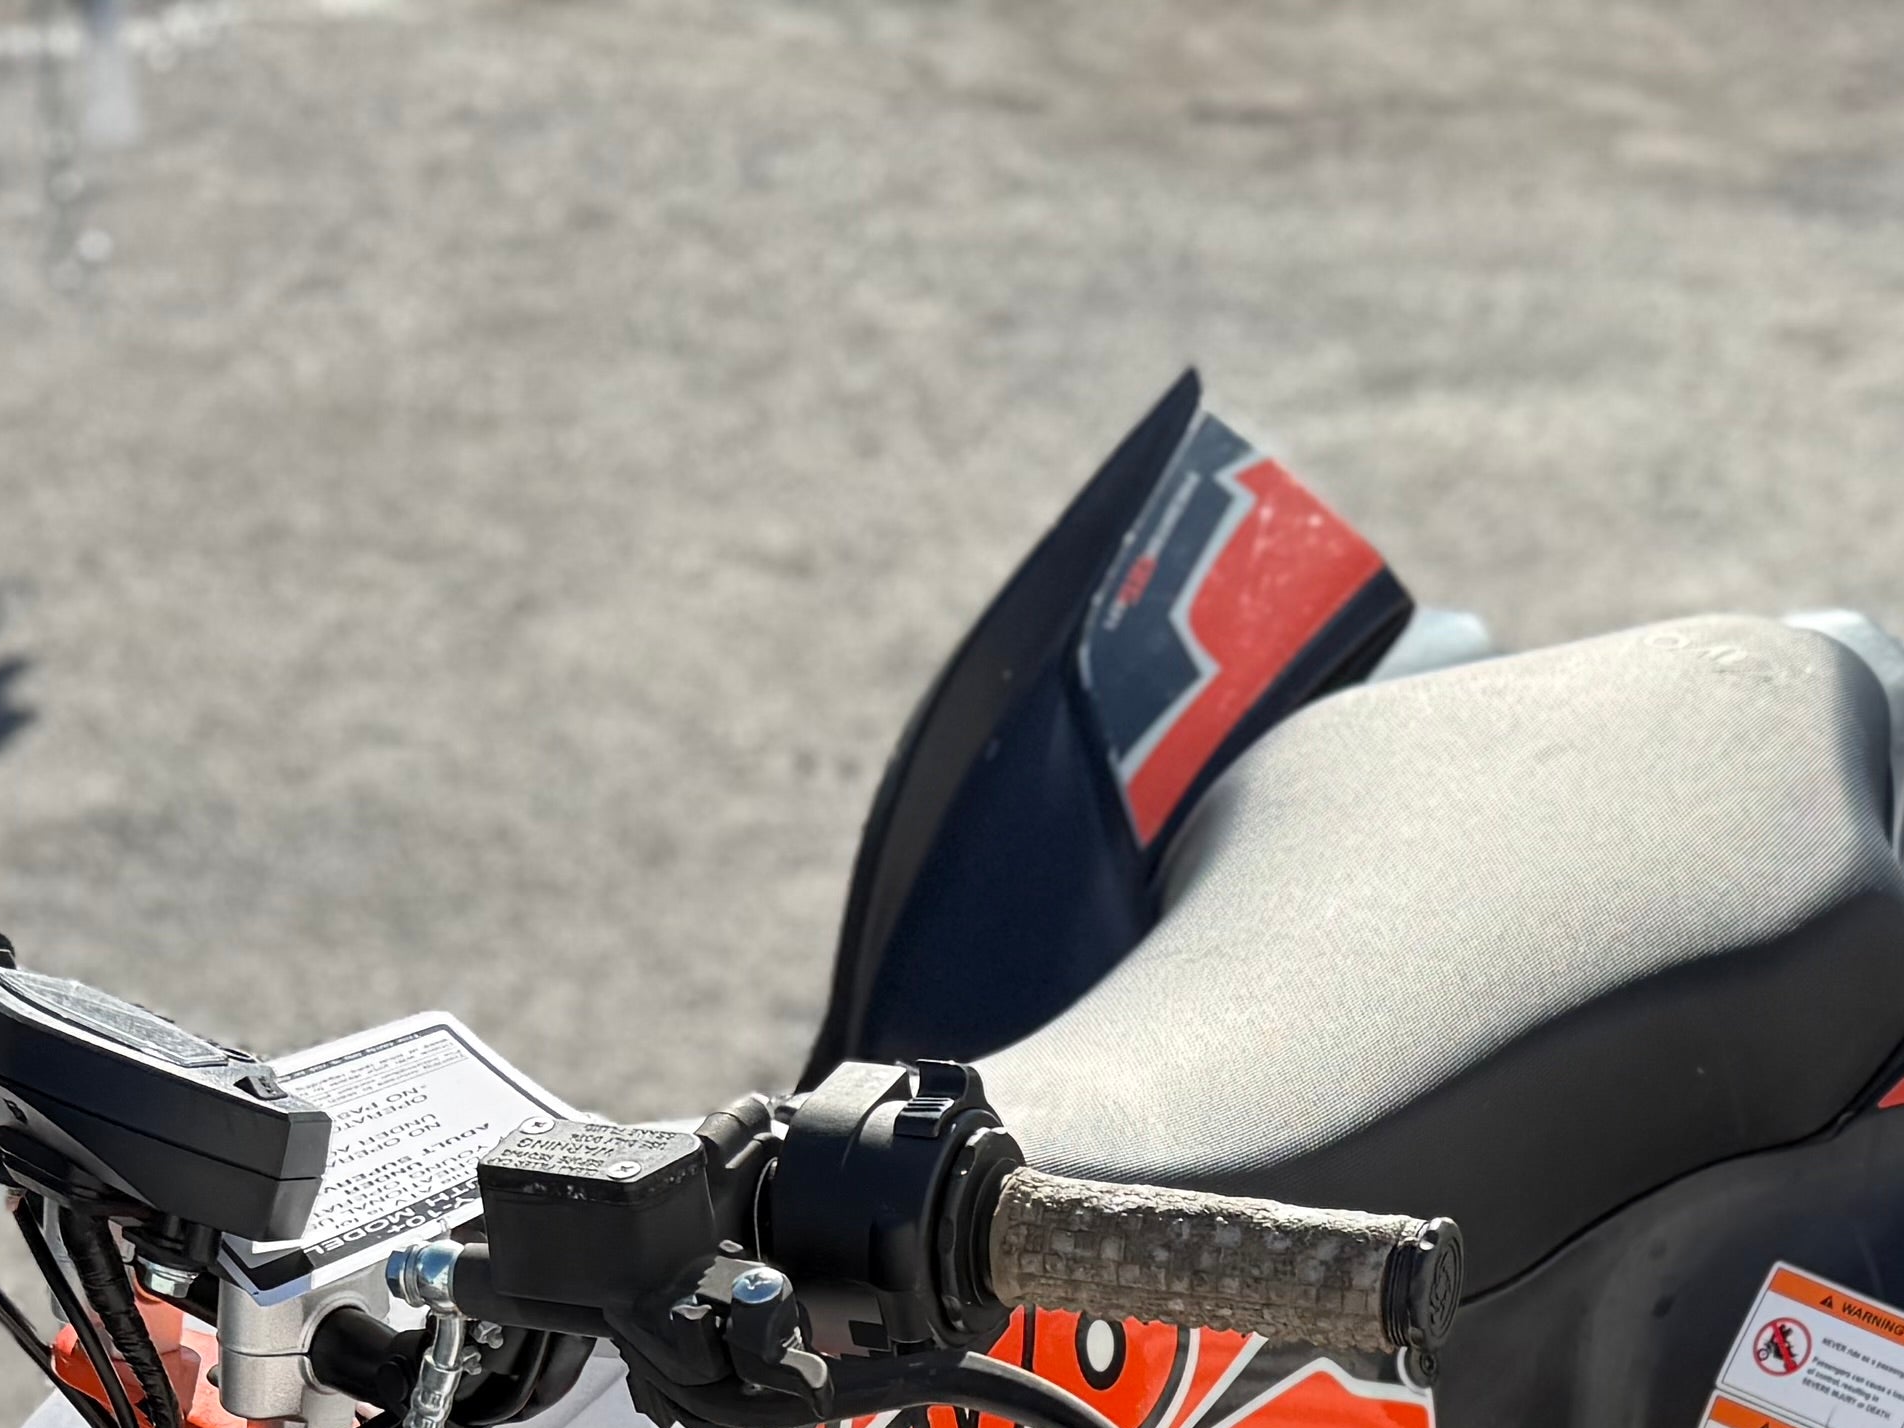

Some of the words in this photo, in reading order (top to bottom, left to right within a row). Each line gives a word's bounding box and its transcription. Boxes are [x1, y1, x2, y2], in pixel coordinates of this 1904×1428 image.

[358, 1113, 436, 1146] UNDER
[408, 1121, 441, 1138] NO
[422, 1122, 489, 1154] ADULT
[517, 1137, 615, 1157] WARNING
[324, 1156, 412, 1194] SUPERV
[344, 1161, 423, 1195] UNDER
[303, 1207, 416, 1255] MODEL
[1842, 1302, 1904, 1337] WARNING
[1802, 1377, 1831, 1394] SEVERE
